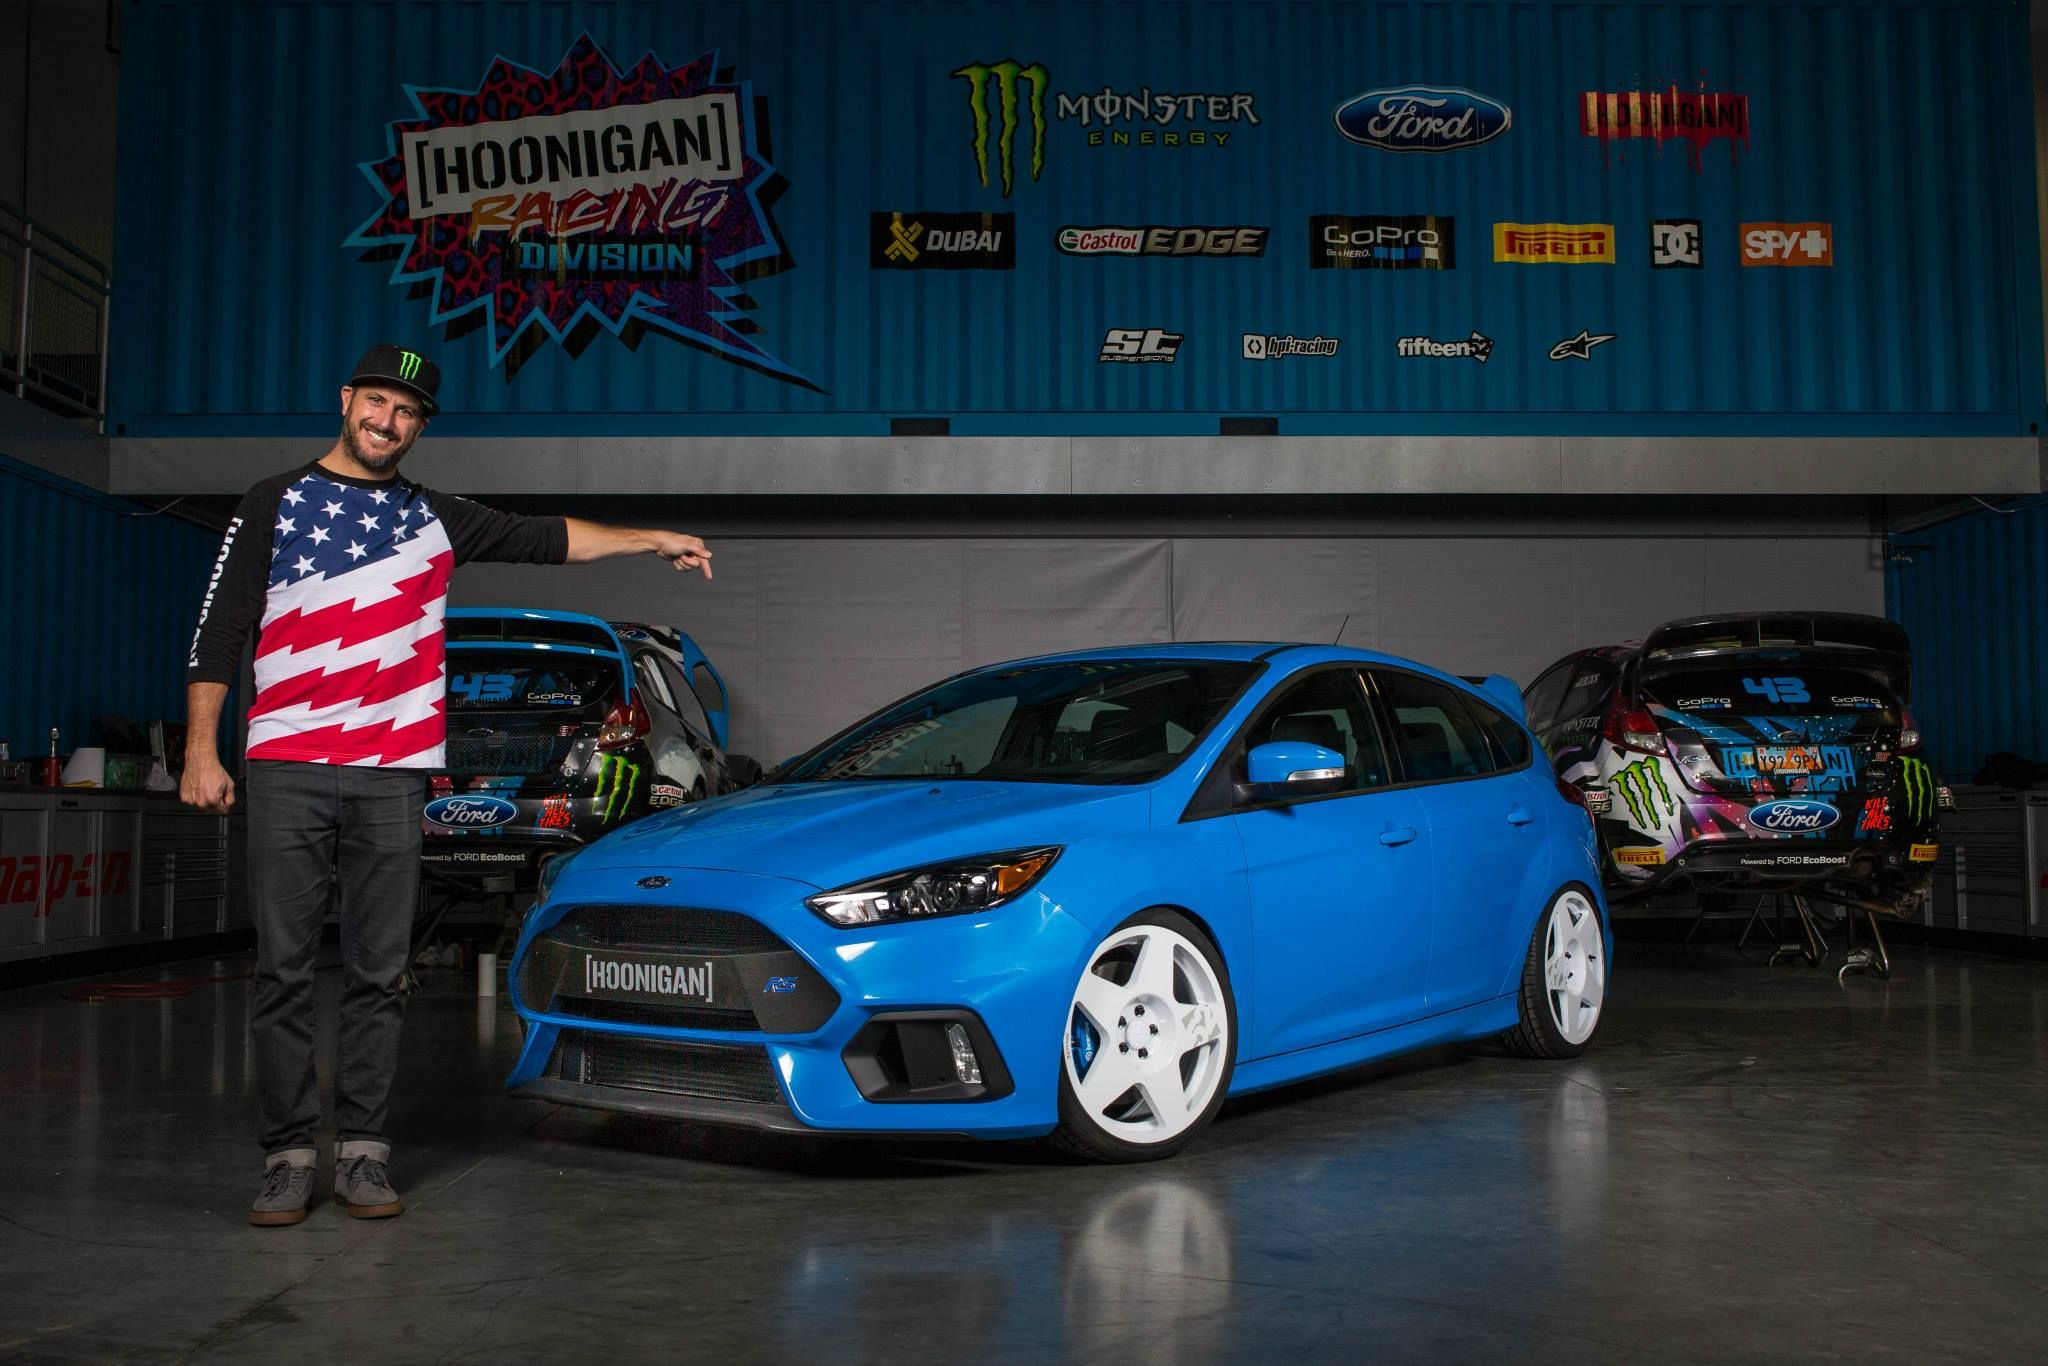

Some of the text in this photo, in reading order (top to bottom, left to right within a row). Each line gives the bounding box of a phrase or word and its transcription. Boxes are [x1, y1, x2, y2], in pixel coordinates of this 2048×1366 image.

[1057, 87, 1260, 125] MONSTER
[1368, 95, 1475, 140] Ford
[1090, 131, 1229, 146] ENERGY
[469, 178, 728, 246] RACING
[926, 229, 1002, 252] DUBAI
[1079, 229, 1265, 254] Castrol EDGE
[1324, 225, 1439, 245] GoPro
[1504, 230, 1605, 256] PIRELLI
[1653, 224, 1699, 265] DC
[519, 243, 692, 272] DIVISION
[448, 672, 516, 702] 43
[527, 692, 582, 701] GoPro
[1741, 676, 1811, 704] 43
[1677, 697, 1731, 706] GoPro
[1831, 696, 1880, 704] GoPro
[658, 786, 682, 797] Castrol
[440, 799, 498, 825] Ford
[1766, 803, 1823, 827] Ford
[453, 853, 479, 862] FORD
[480, 853, 526, 862] EcoBoost
[1766, 858, 1775, 866] by
[1777, 856, 1802, 865] FORD
[1803, 856, 1846, 864] EcoBoost
[586, 954, 713, 1003] [HOONIGAN]
[763, 976, 799, 993] RS
